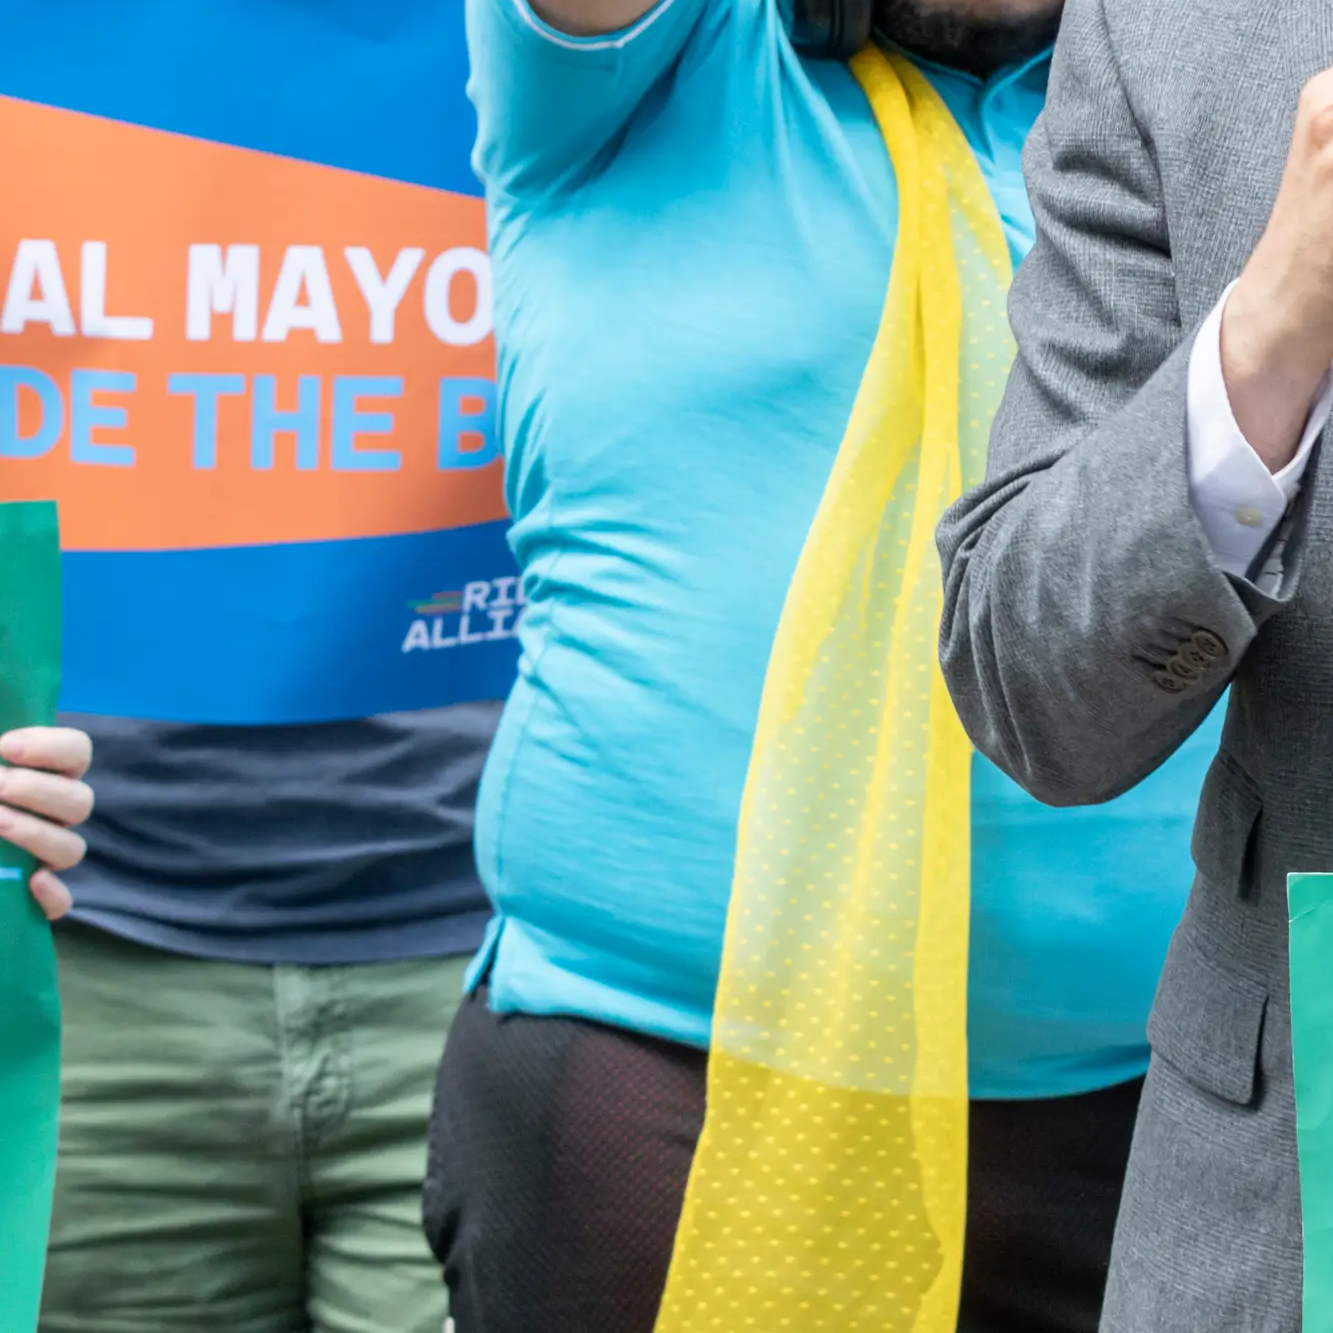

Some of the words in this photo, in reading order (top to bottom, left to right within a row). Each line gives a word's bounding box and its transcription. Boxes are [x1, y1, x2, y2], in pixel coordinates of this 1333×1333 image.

[1, 237, 154, 340] AL
[185, 243, 493, 346] MAYO
[0, 363, 137, 469] DE
[167, 372, 404, 473] THE
[436, 376, 500, 471] B
